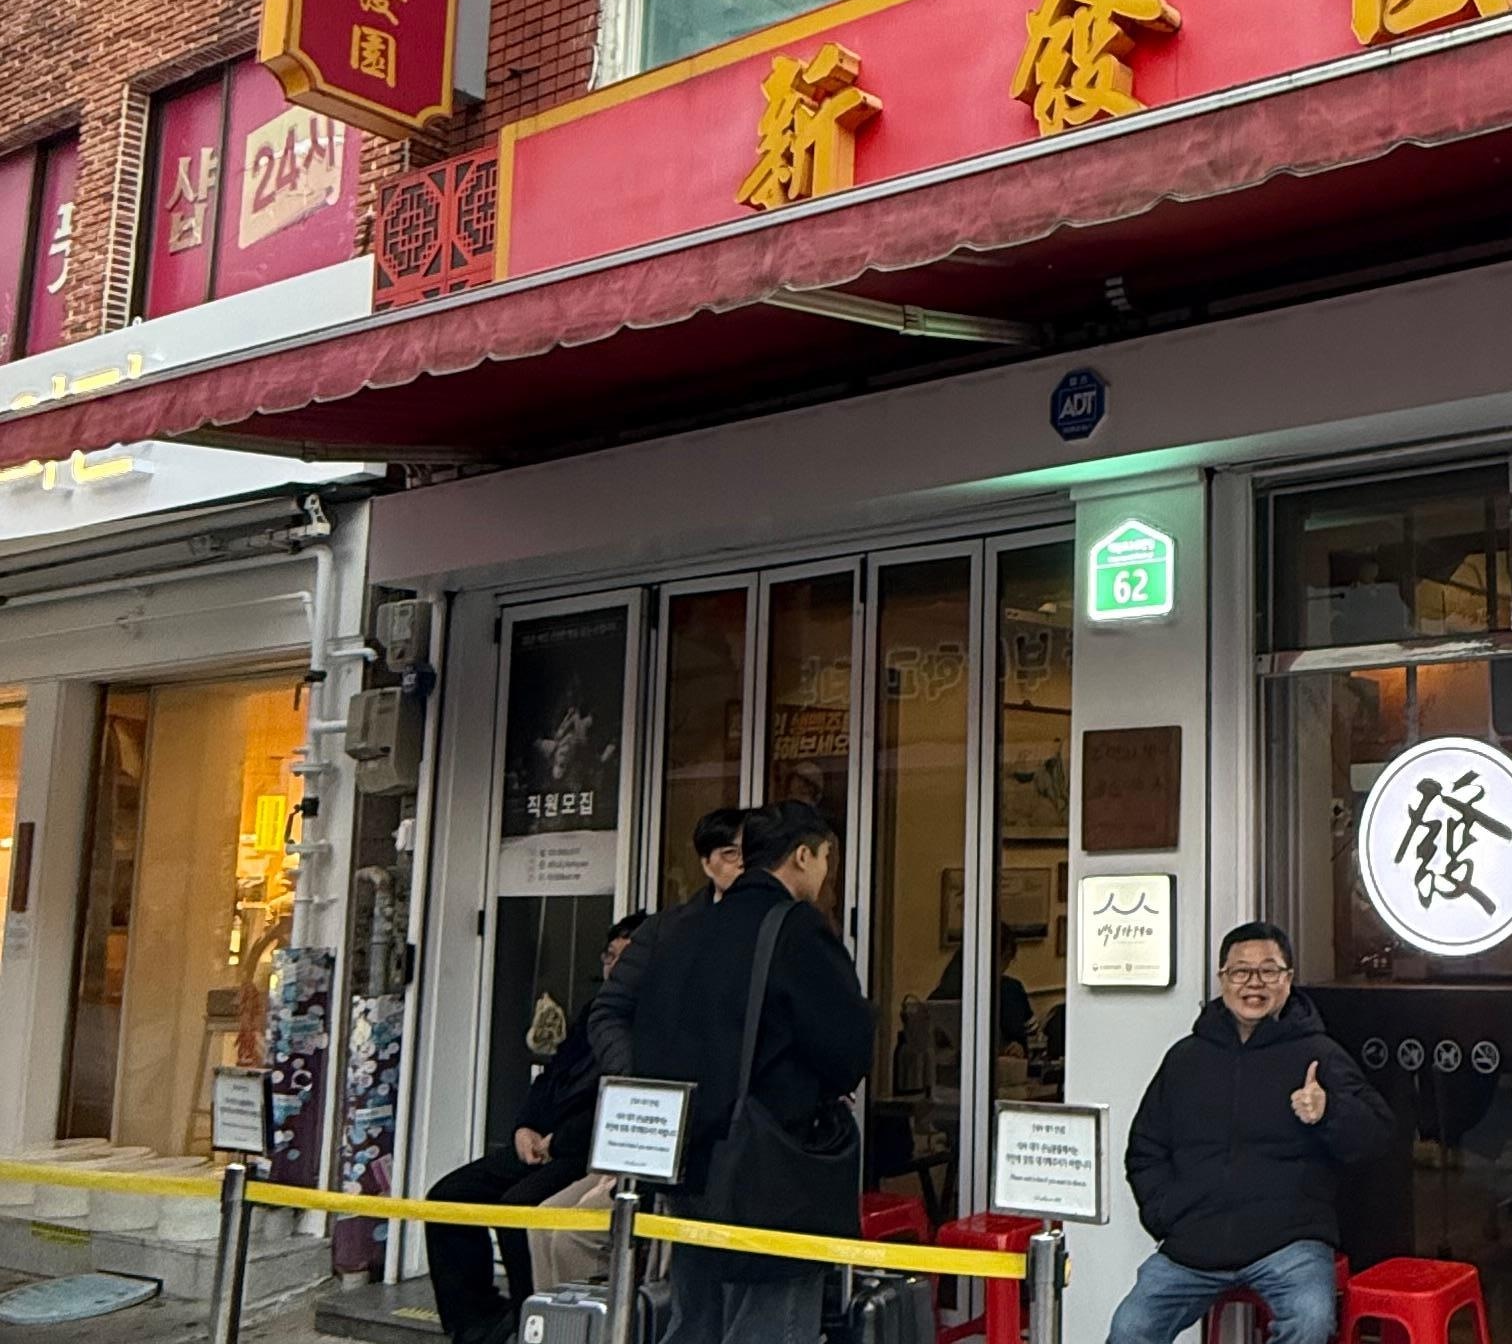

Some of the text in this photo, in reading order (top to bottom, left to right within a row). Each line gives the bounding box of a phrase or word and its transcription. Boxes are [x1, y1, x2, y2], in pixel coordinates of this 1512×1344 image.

[1058, 390, 1097, 419] ADT
[1113, 568, 1149, 604] 62
[527, 791, 593, 818] 직원모집
